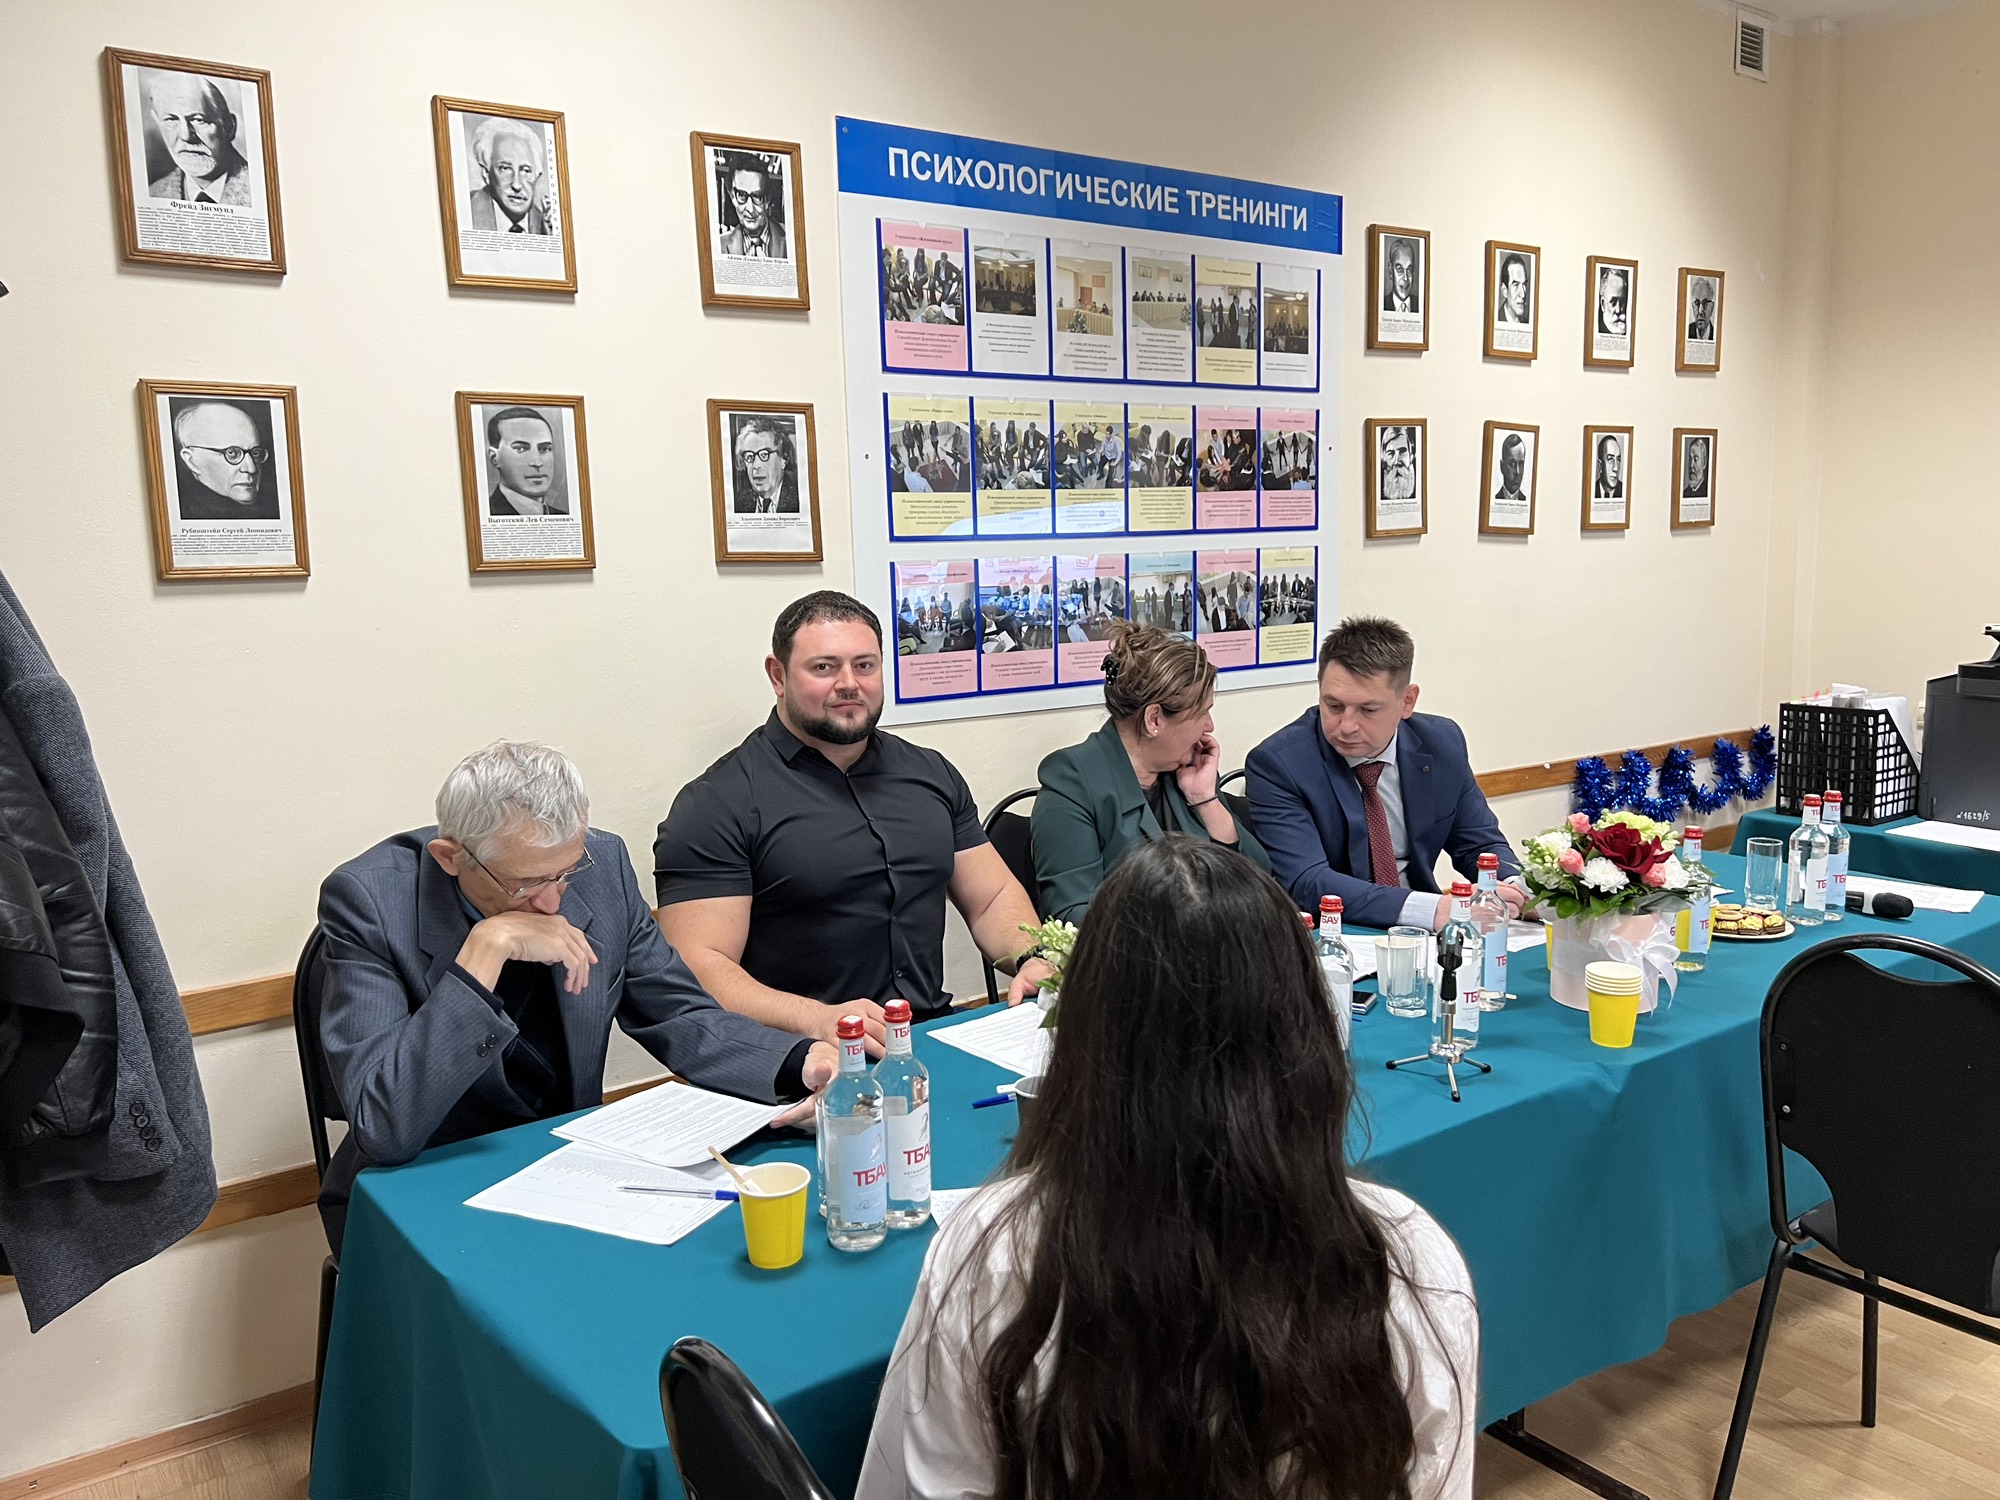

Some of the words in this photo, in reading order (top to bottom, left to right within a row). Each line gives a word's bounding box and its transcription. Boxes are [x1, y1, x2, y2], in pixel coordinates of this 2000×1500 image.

[888, 146, 1179, 214] ПСИХОЛОГИЧЕСКИЕ
[1186, 189, 1308, 232] ТРЕНИНГИ
[170, 200, 198, 211] Фрейд
[199, 204, 234, 214] Зигмунд
[1321, 915, 1339, 924] БАУ
